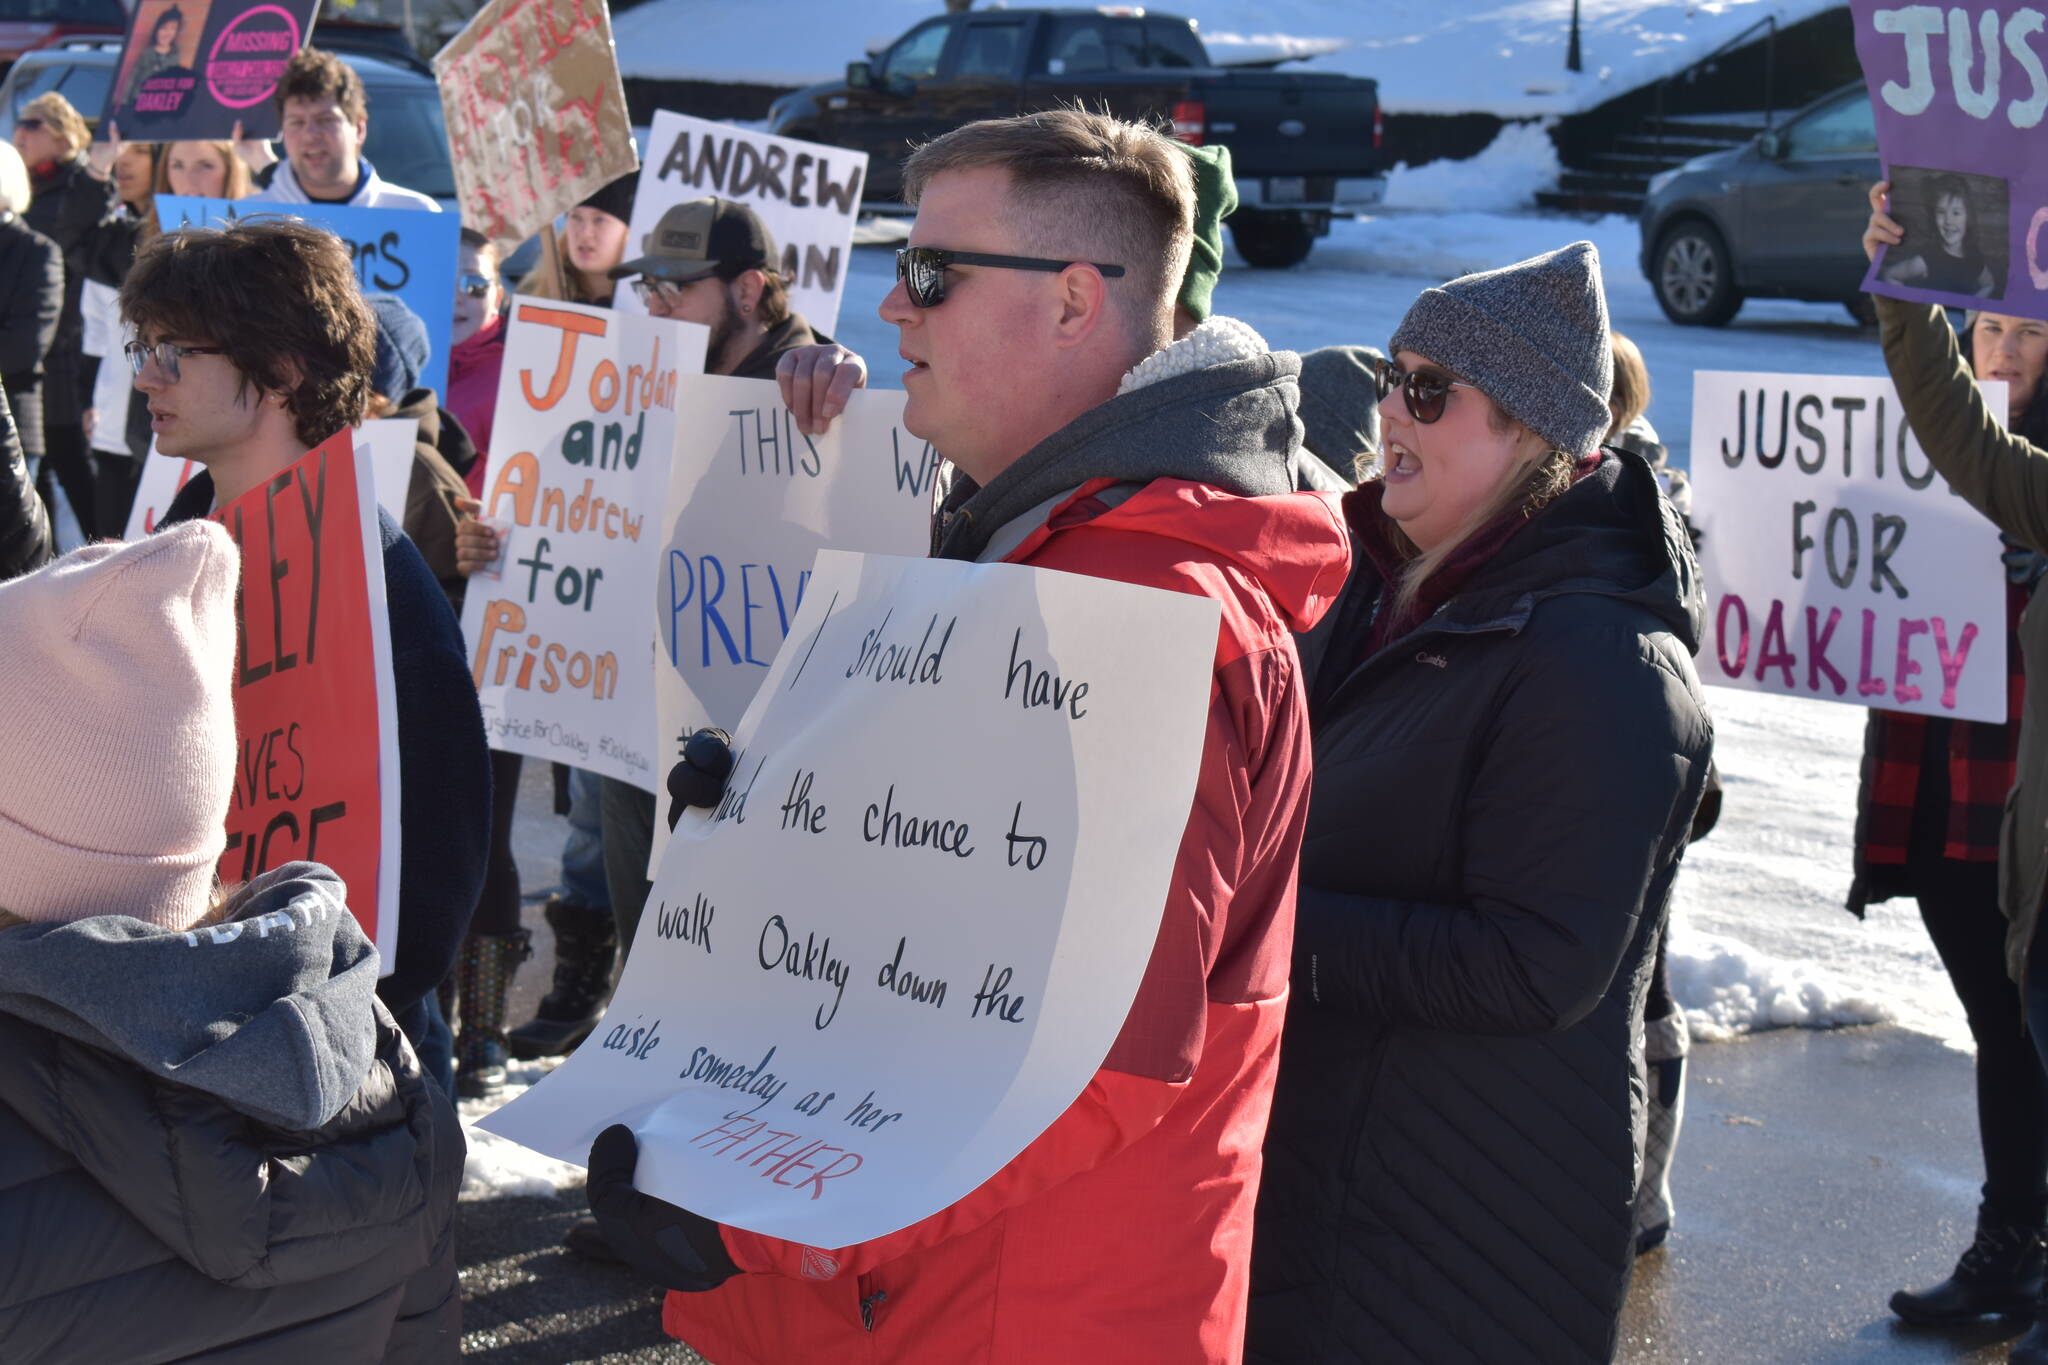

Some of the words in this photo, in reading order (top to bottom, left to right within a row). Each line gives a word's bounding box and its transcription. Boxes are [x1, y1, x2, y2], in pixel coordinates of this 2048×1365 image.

[657, 130, 862, 216] ANDREW
[517, 304, 678, 416] Jordan
[561, 411, 646, 472] and
[729, 407, 822, 478] THIS
[1721, 388, 1950, 496] JUSTIC
[489, 451, 644, 543] Andrew
[220, 450, 326, 688] LEY
[517, 537, 604, 612] for
[1791, 499, 1910, 599] FOR
[474, 599, 619, 700] Prison
[669, 549, 813, 669] PREV
[1715, 593, 1980, 711] OAKLEY
[845, 607, 957, 686] should
[1005, 627, 1090, 720] have
[781, 768, 828, 834] the
[863, 783, 976, 859] chance
[1005, 801, 1048, 871] to
[657, 892, 715, 954] walk
[758, 914, 850, 1031] Oakley
[878, 936, 948, 1009] down
[971, 963, 1025, 1024] the
[603, 1014, 661, 1061] aisle
[680, 1045, 788, 1120] someday
[794, 1088, 836, 1118] as
[844, 1090, 903, 1134] her
[689, 1114, 864, 1201] FATHER
